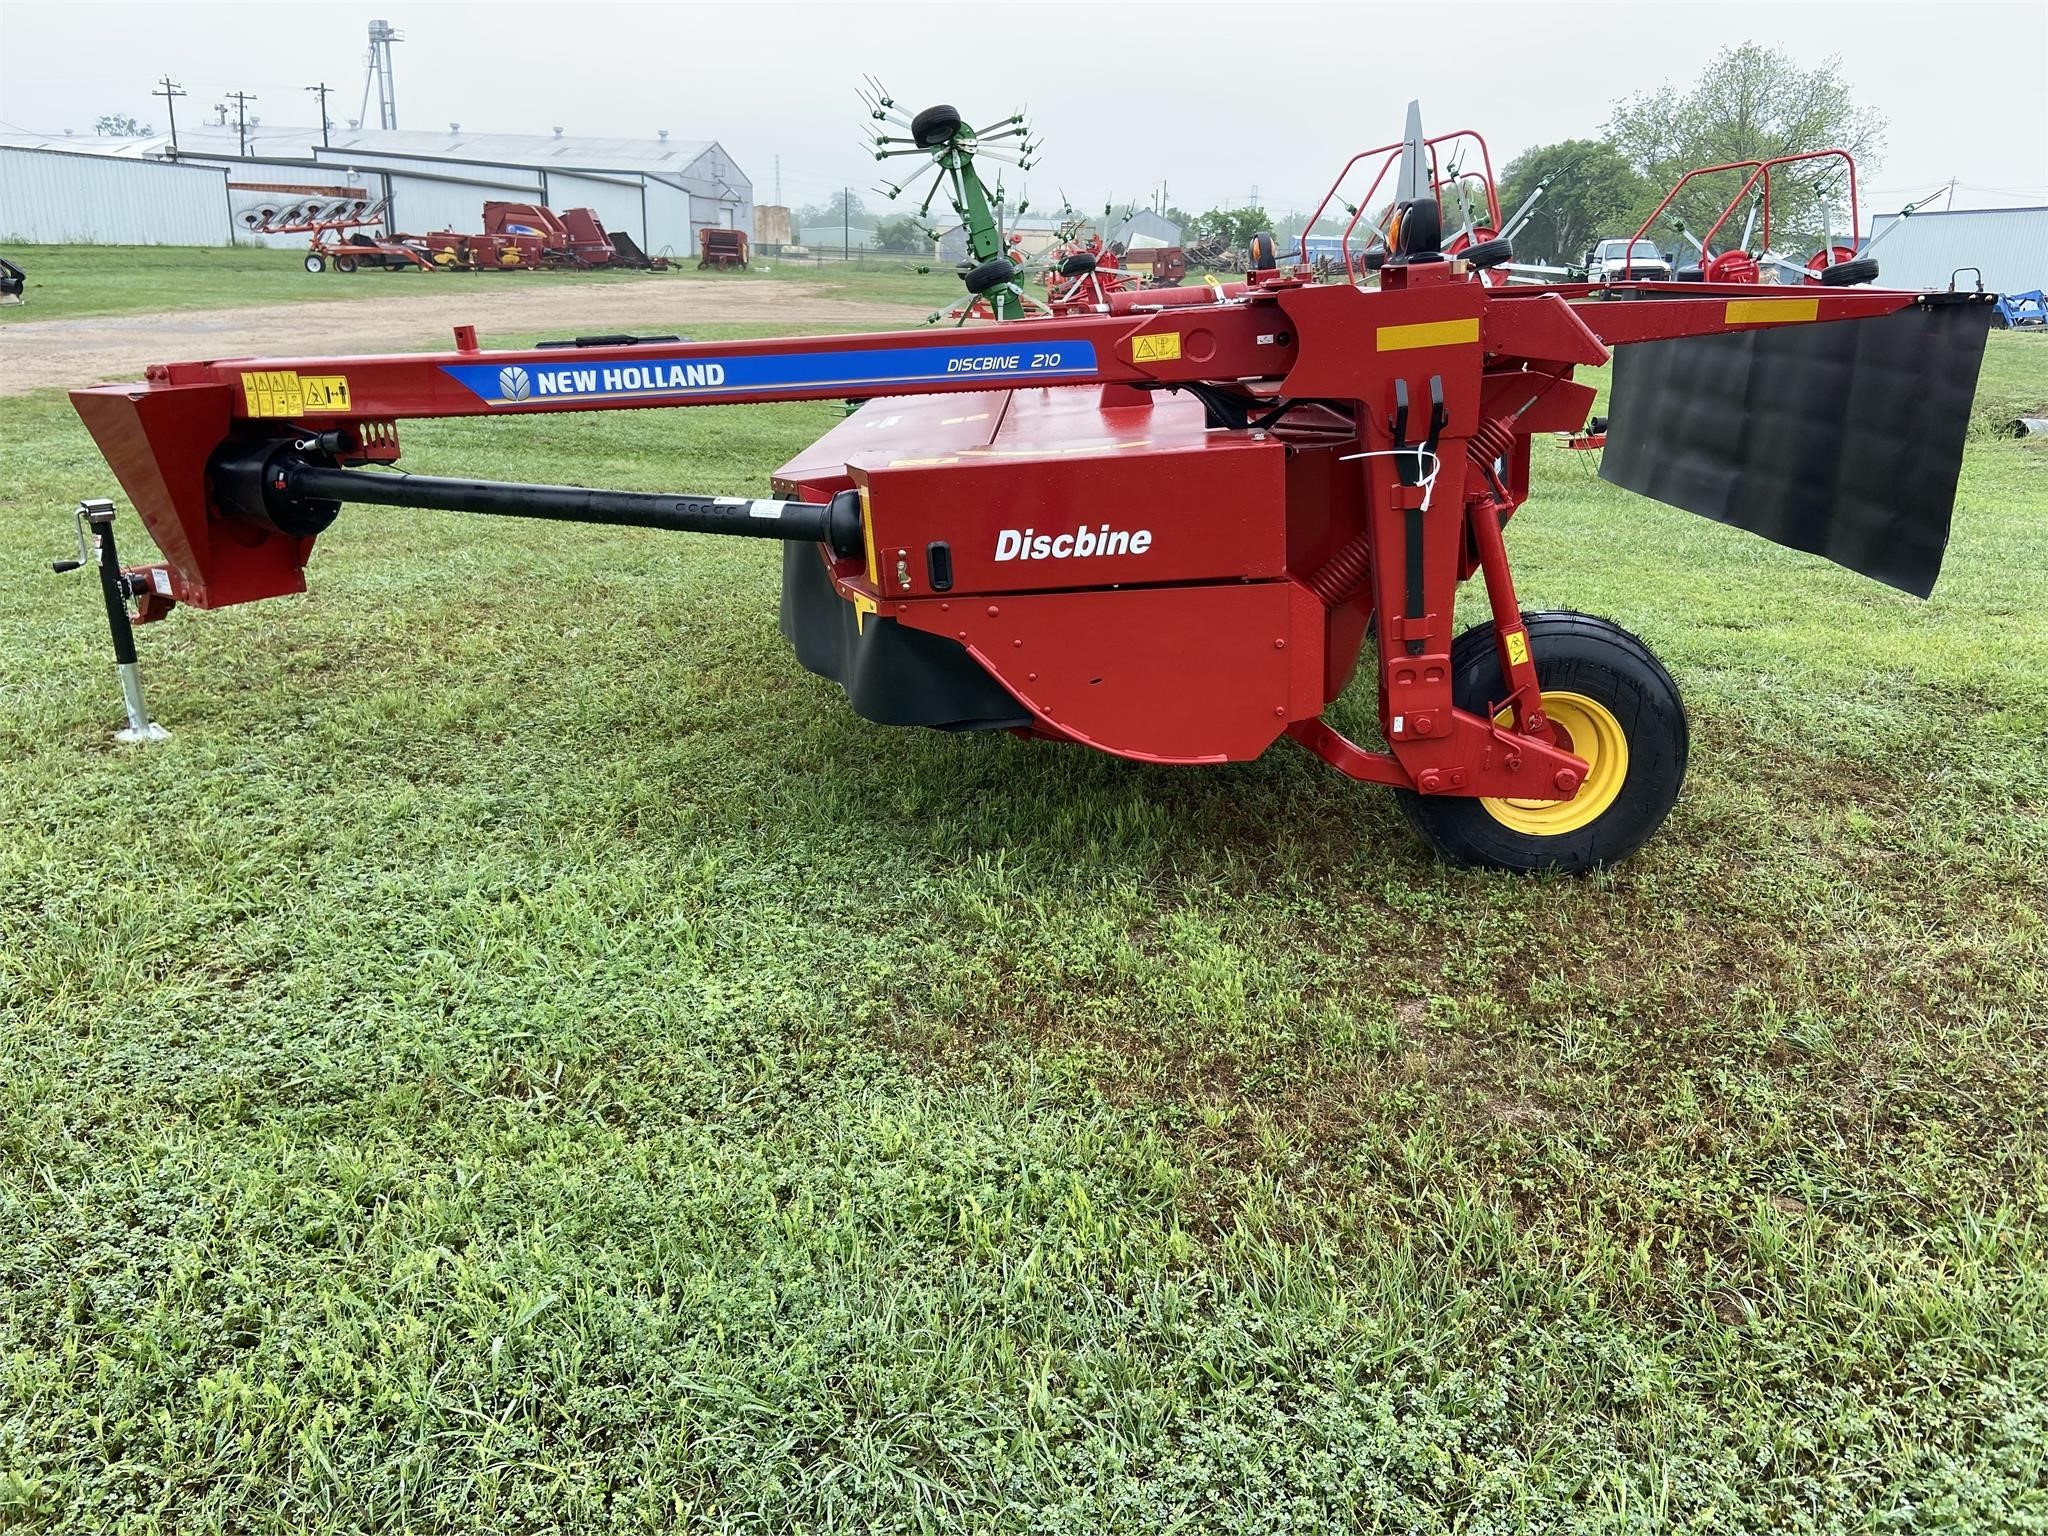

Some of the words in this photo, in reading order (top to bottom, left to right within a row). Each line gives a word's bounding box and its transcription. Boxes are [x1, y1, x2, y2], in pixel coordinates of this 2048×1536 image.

[947, 355, 1020, 372] DISCBINE
[1031, 353, 1061, 368] 210
[538, 370, 597, 394] NEW
[603, 364, 725, 391] HOLLAND
[994, 524, 1152, 562] Discbine
